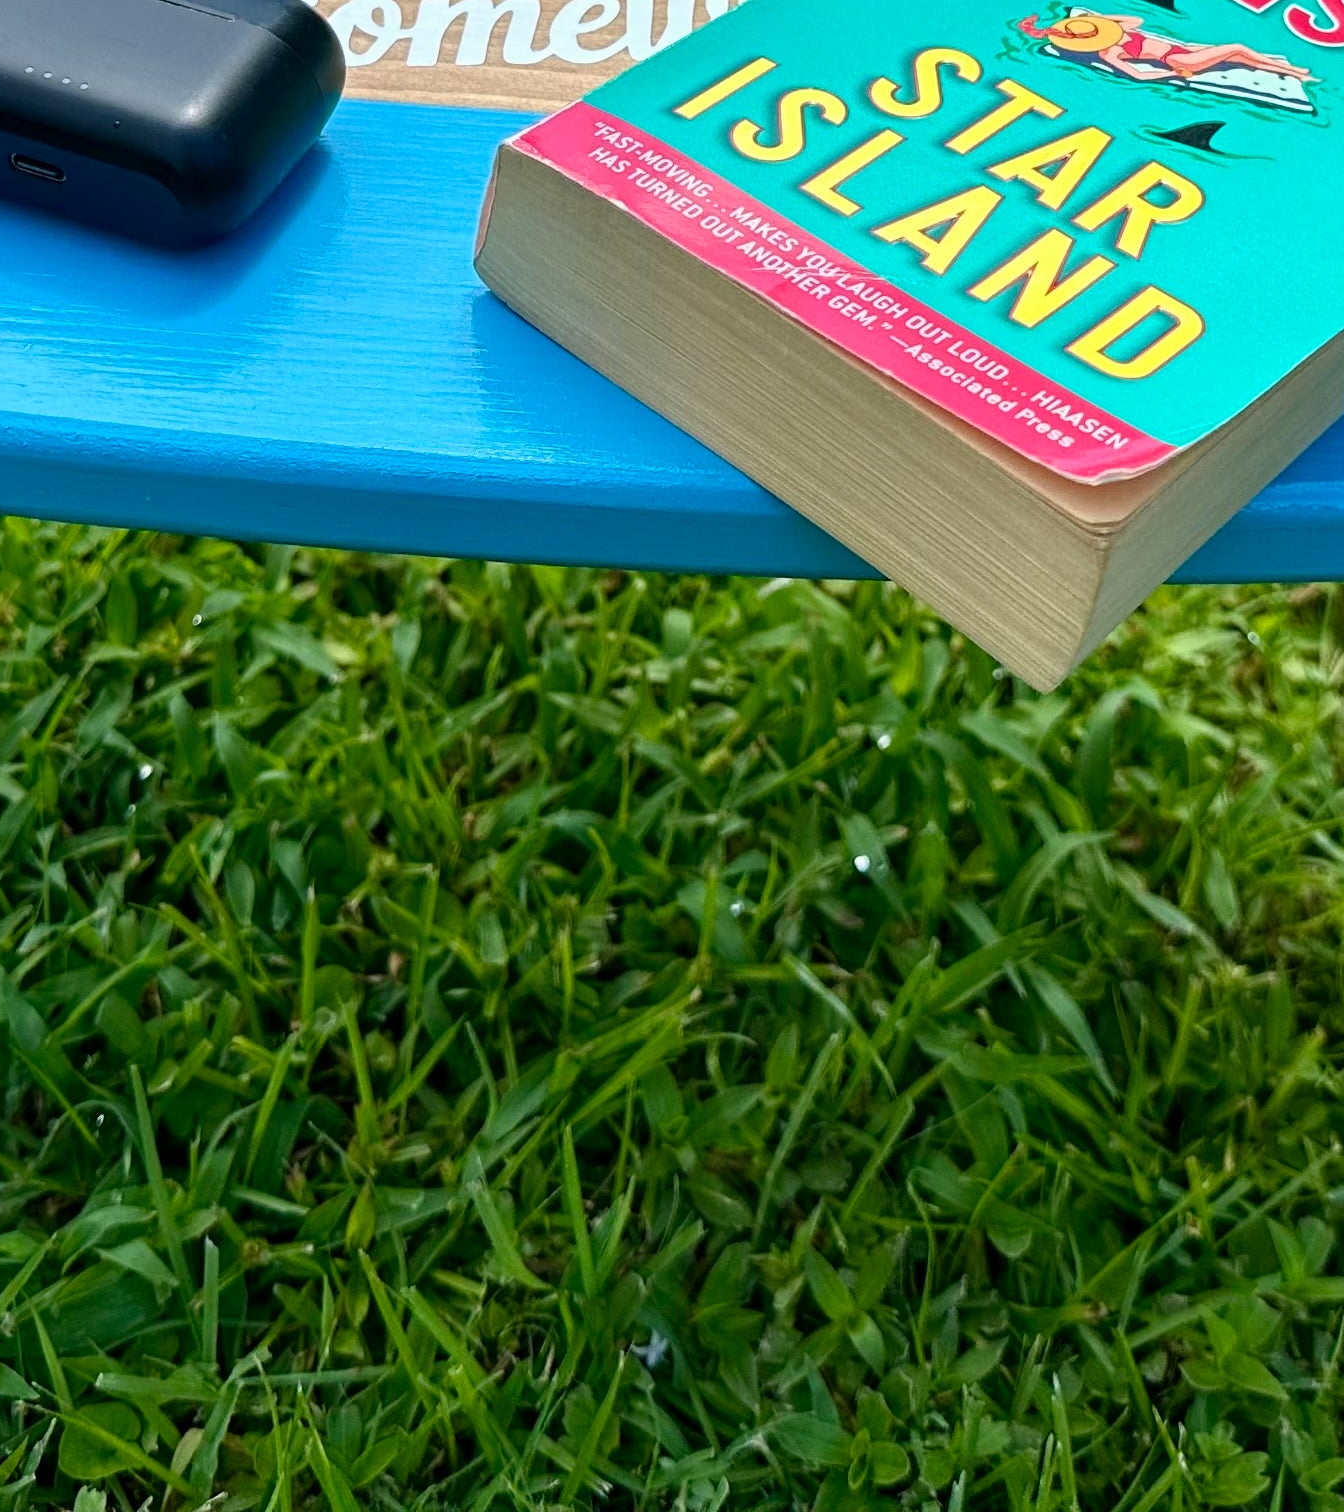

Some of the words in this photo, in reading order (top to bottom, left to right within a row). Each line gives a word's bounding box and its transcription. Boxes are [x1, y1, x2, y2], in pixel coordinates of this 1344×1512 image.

[673, 56, 1206, 380] ISLAND
[868, 47, 1205, 260] STAR
[588, 146, 632, 174] HAS
[627, 168, 704, 220] TURNED
[699, 215, 745, 245] OUT
[736, 241, 832, 300] ANOTHER
[1014, 408, 1076, 449] Press
[729, 206, 799, 253] MAKES
[796, 246, 844, 278] YOU
[835, 272, 909, 320] LAUGH
[905, 314, 953, 345] OUT
[1030, 390, 1129, 450] HIAASEN
